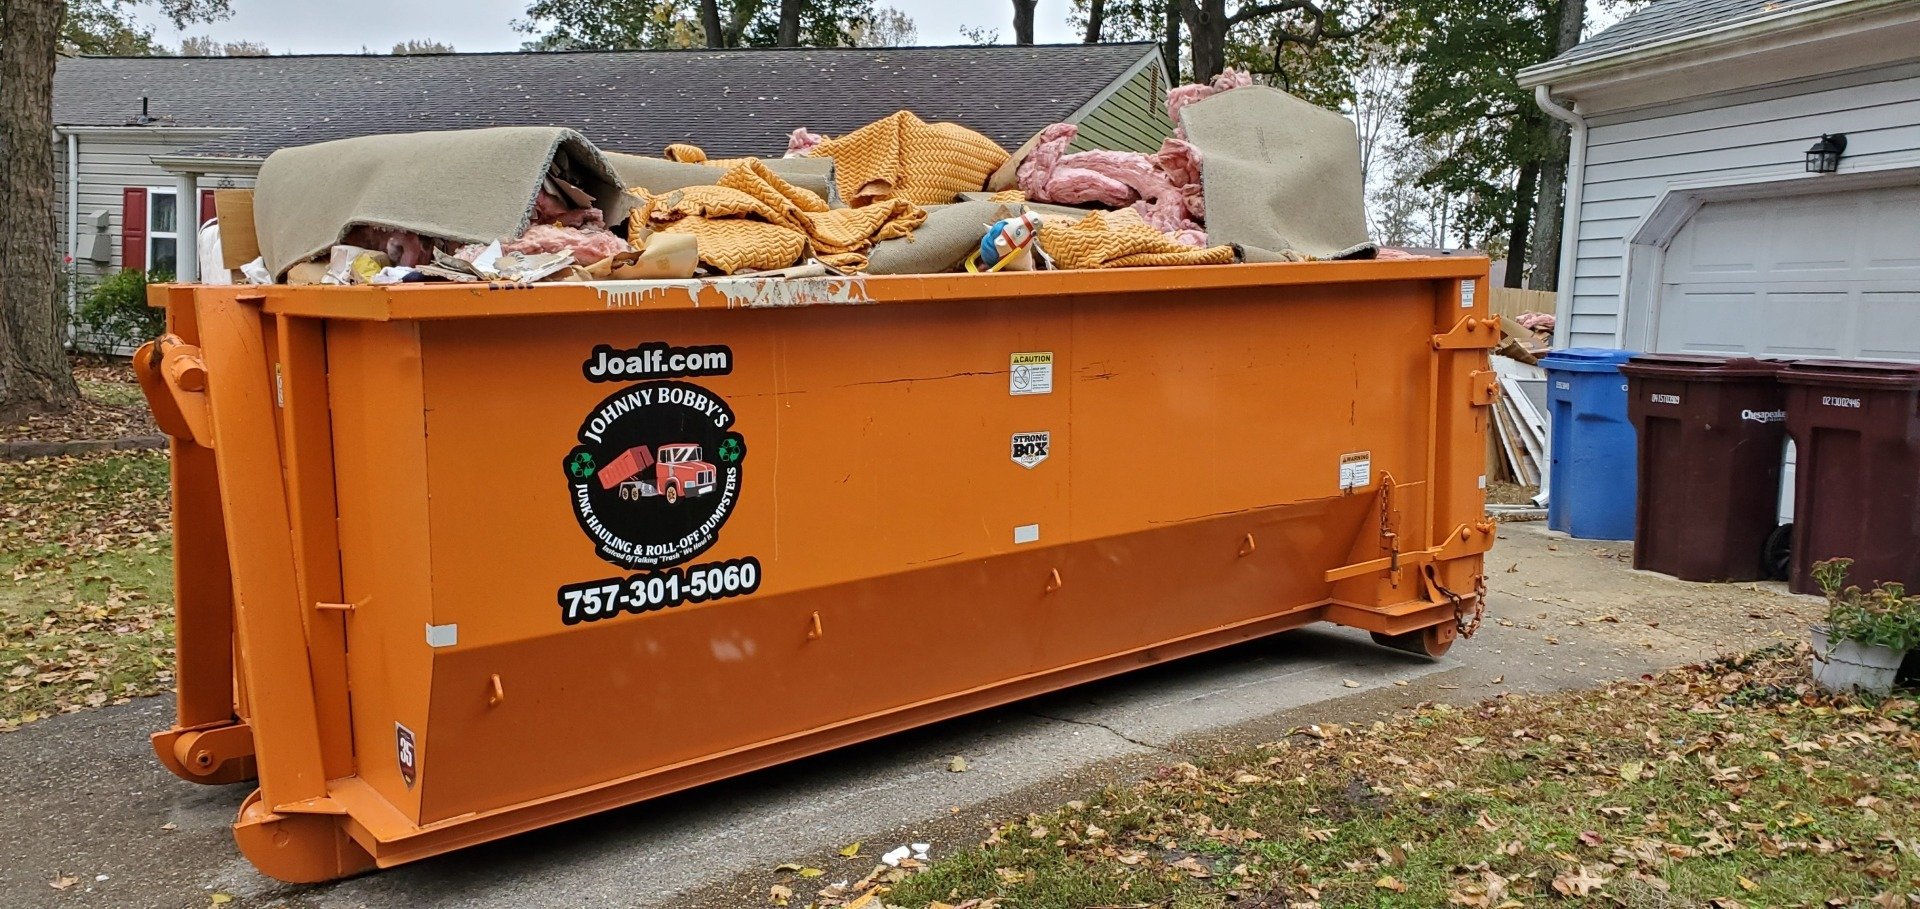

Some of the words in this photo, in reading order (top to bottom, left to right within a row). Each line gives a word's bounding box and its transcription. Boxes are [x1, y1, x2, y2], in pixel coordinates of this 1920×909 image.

[590, 350, 727, 376] Joalf.com
[1020, 355, 1051, 363] CAUTION
[585, 388, 653, 444] JOHNNY
[657, 387, 729, 428] BOBBY'S
[1013, 434, 1047, 443] STRONG
[1013, 442, 1048, 457] BOX
[1346, 453, 1369, 462] WARNING
[575, 484, 594, 518] JUNK
[586, 515, 632, 554] HAULING
[633, 544, 643, 556] &
[646, 530, 700, 556] ROLL-OFF
[700, 467, 737, 536] DUMPSTERS
[602, 544, 626, 560] Instead
[625, 554, 635, 563] Of
[633, 556, 659, 565] Talking
[693, 538, 707, 550] Haul
[564, 563, 756, 618] 757-301-5060
[400, 737, 413, 768] 35
